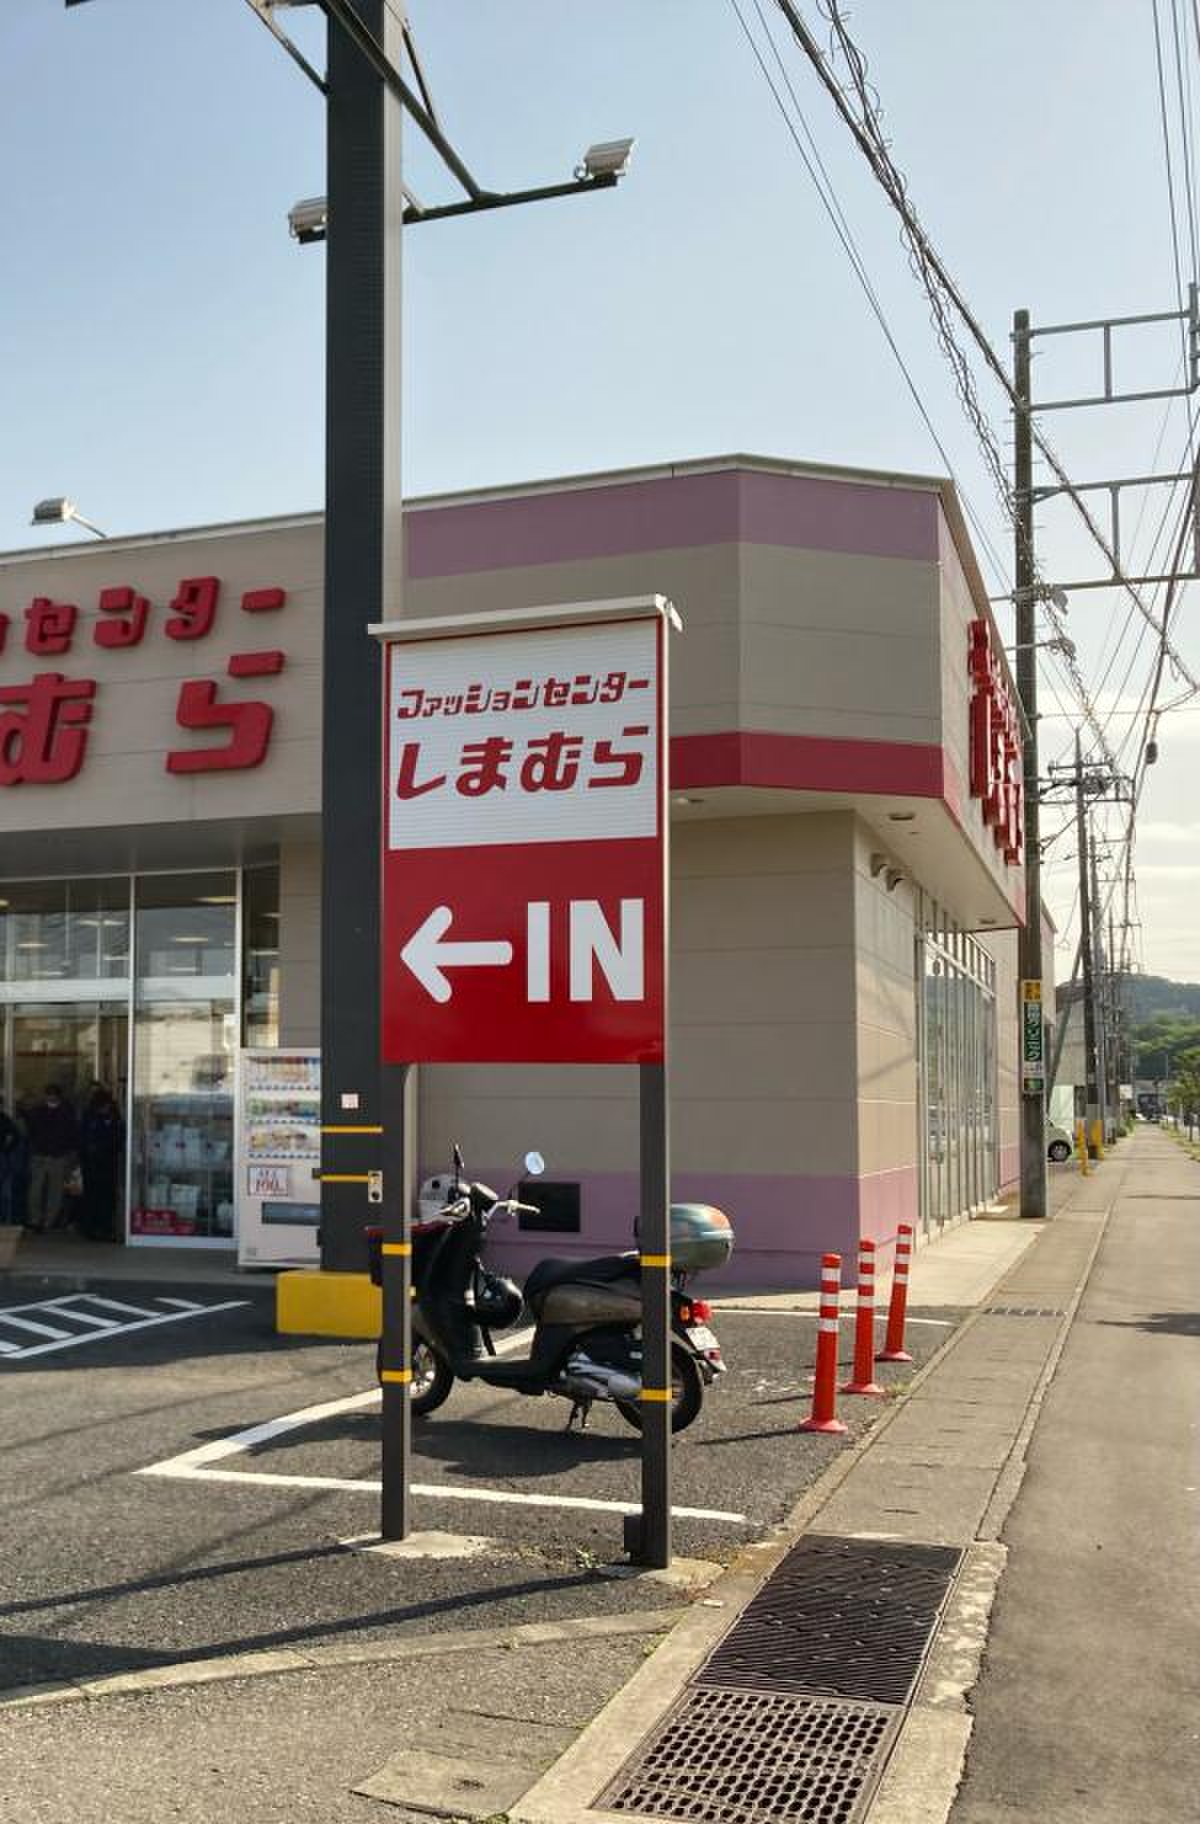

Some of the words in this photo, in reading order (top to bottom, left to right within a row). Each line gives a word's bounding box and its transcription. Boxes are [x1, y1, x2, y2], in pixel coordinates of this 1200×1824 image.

[397, 671, 649, 719] ファッションセンター
[396, 725, 649, 800] しまむら
[527, 898, 644, 1002] IN
